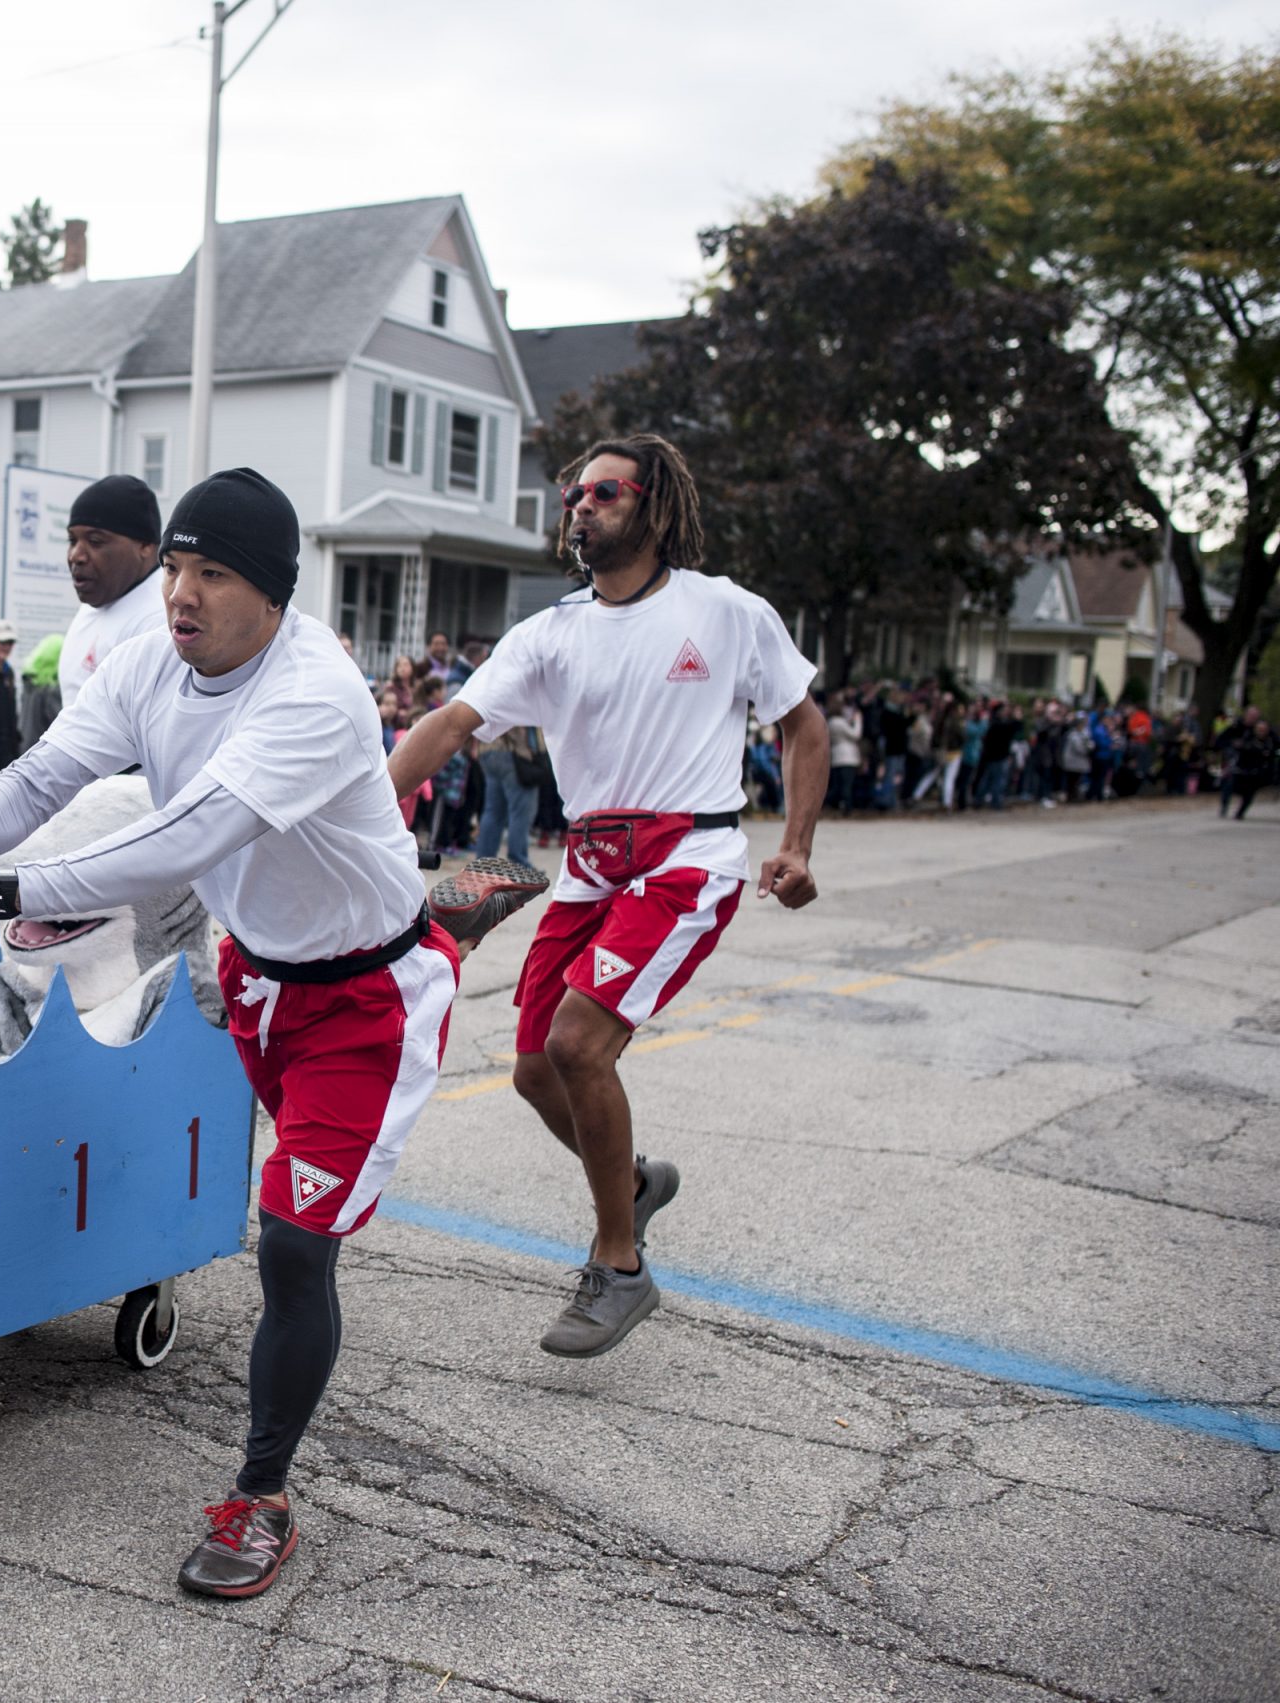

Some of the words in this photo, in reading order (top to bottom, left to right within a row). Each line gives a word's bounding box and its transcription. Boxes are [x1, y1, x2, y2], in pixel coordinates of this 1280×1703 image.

[173, 533, 198, 545] CRAFT
[187, 1117, 200, 1200] 1
[293, 1162, 336, 1186] GUARD
[73, 1142, 88, 1232] 1
